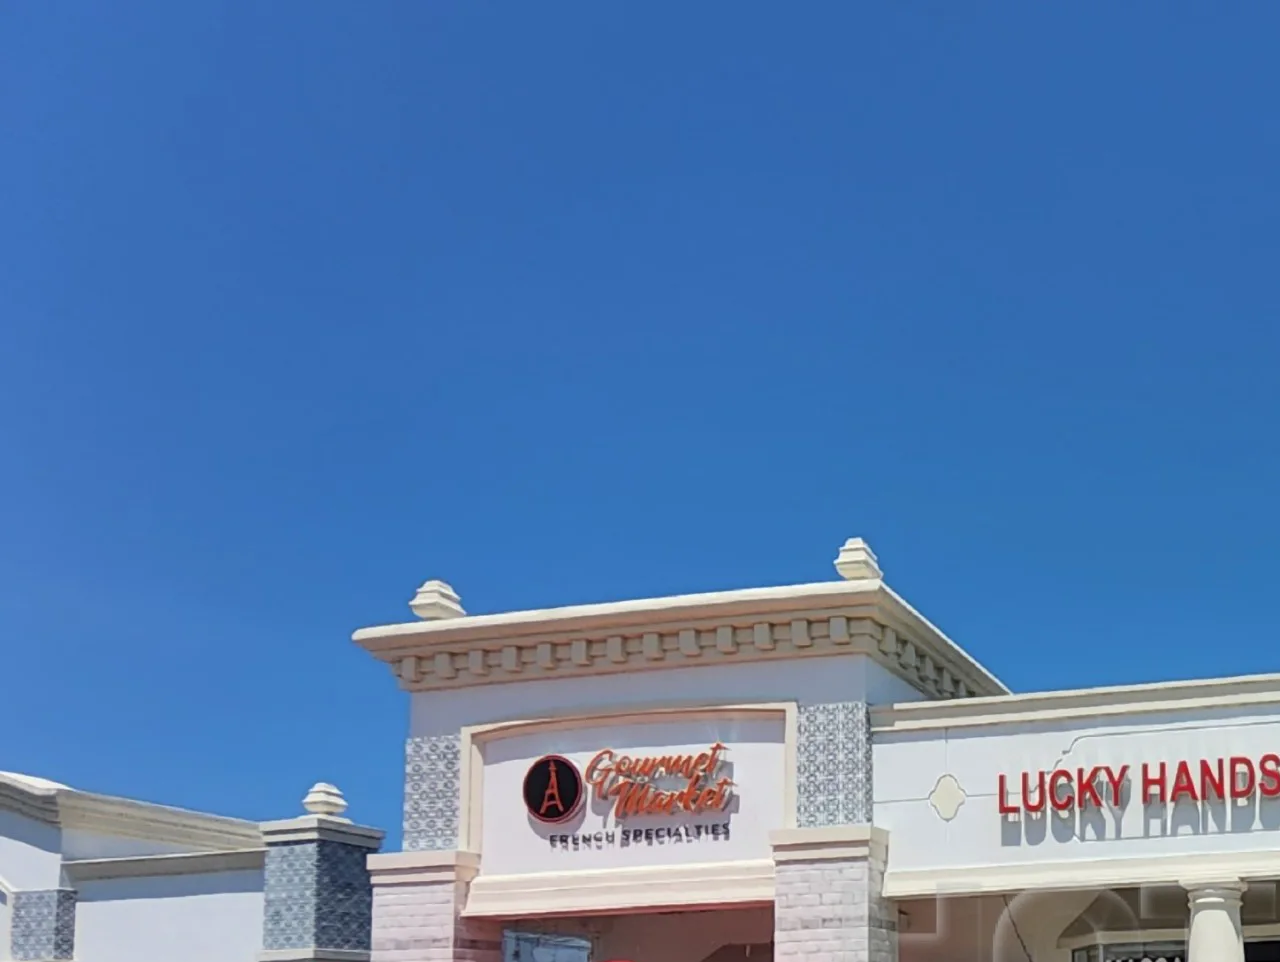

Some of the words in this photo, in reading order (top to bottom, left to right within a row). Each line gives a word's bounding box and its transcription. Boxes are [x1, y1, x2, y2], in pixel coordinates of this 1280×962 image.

[585, 741, 732, 799] Gourmet
[998, 764, 1131, 814] LUCKY
[608, 772, 738, 819] Market
[549, 831, 615, 846] FRENCH
[621, 822, 731, 841] SPECIALTIES
